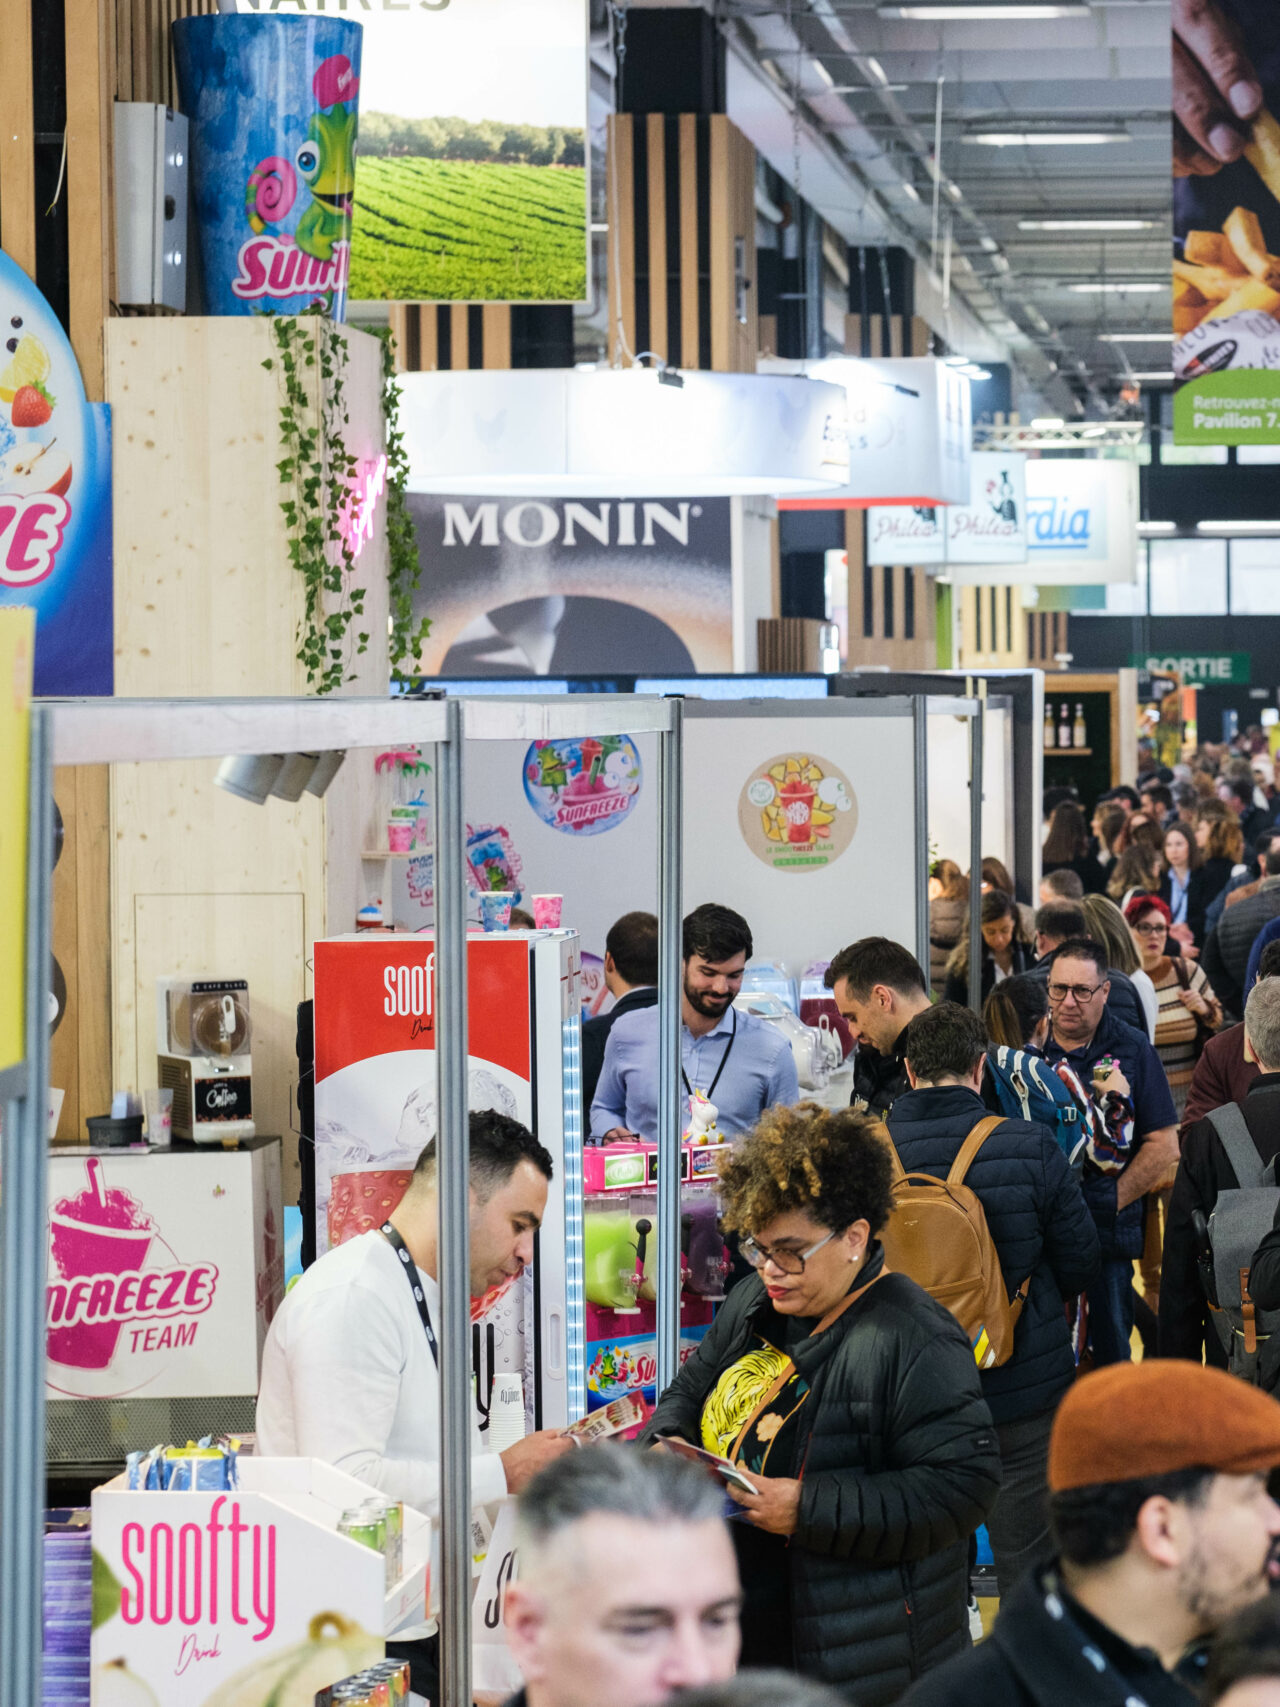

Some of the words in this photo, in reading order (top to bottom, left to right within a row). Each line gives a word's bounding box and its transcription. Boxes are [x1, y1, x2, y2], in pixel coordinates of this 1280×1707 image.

[1194, 412, 1262, 428] Pavilion
[443, 502, 691, 548] MONIN
[1145, 657, 1232, 681] SORTIE
[130, 1321, 199, 1353] TEAM
[121, 1496, 277, 1641] soofty
[175, 1633, 222, 1676] Drink
